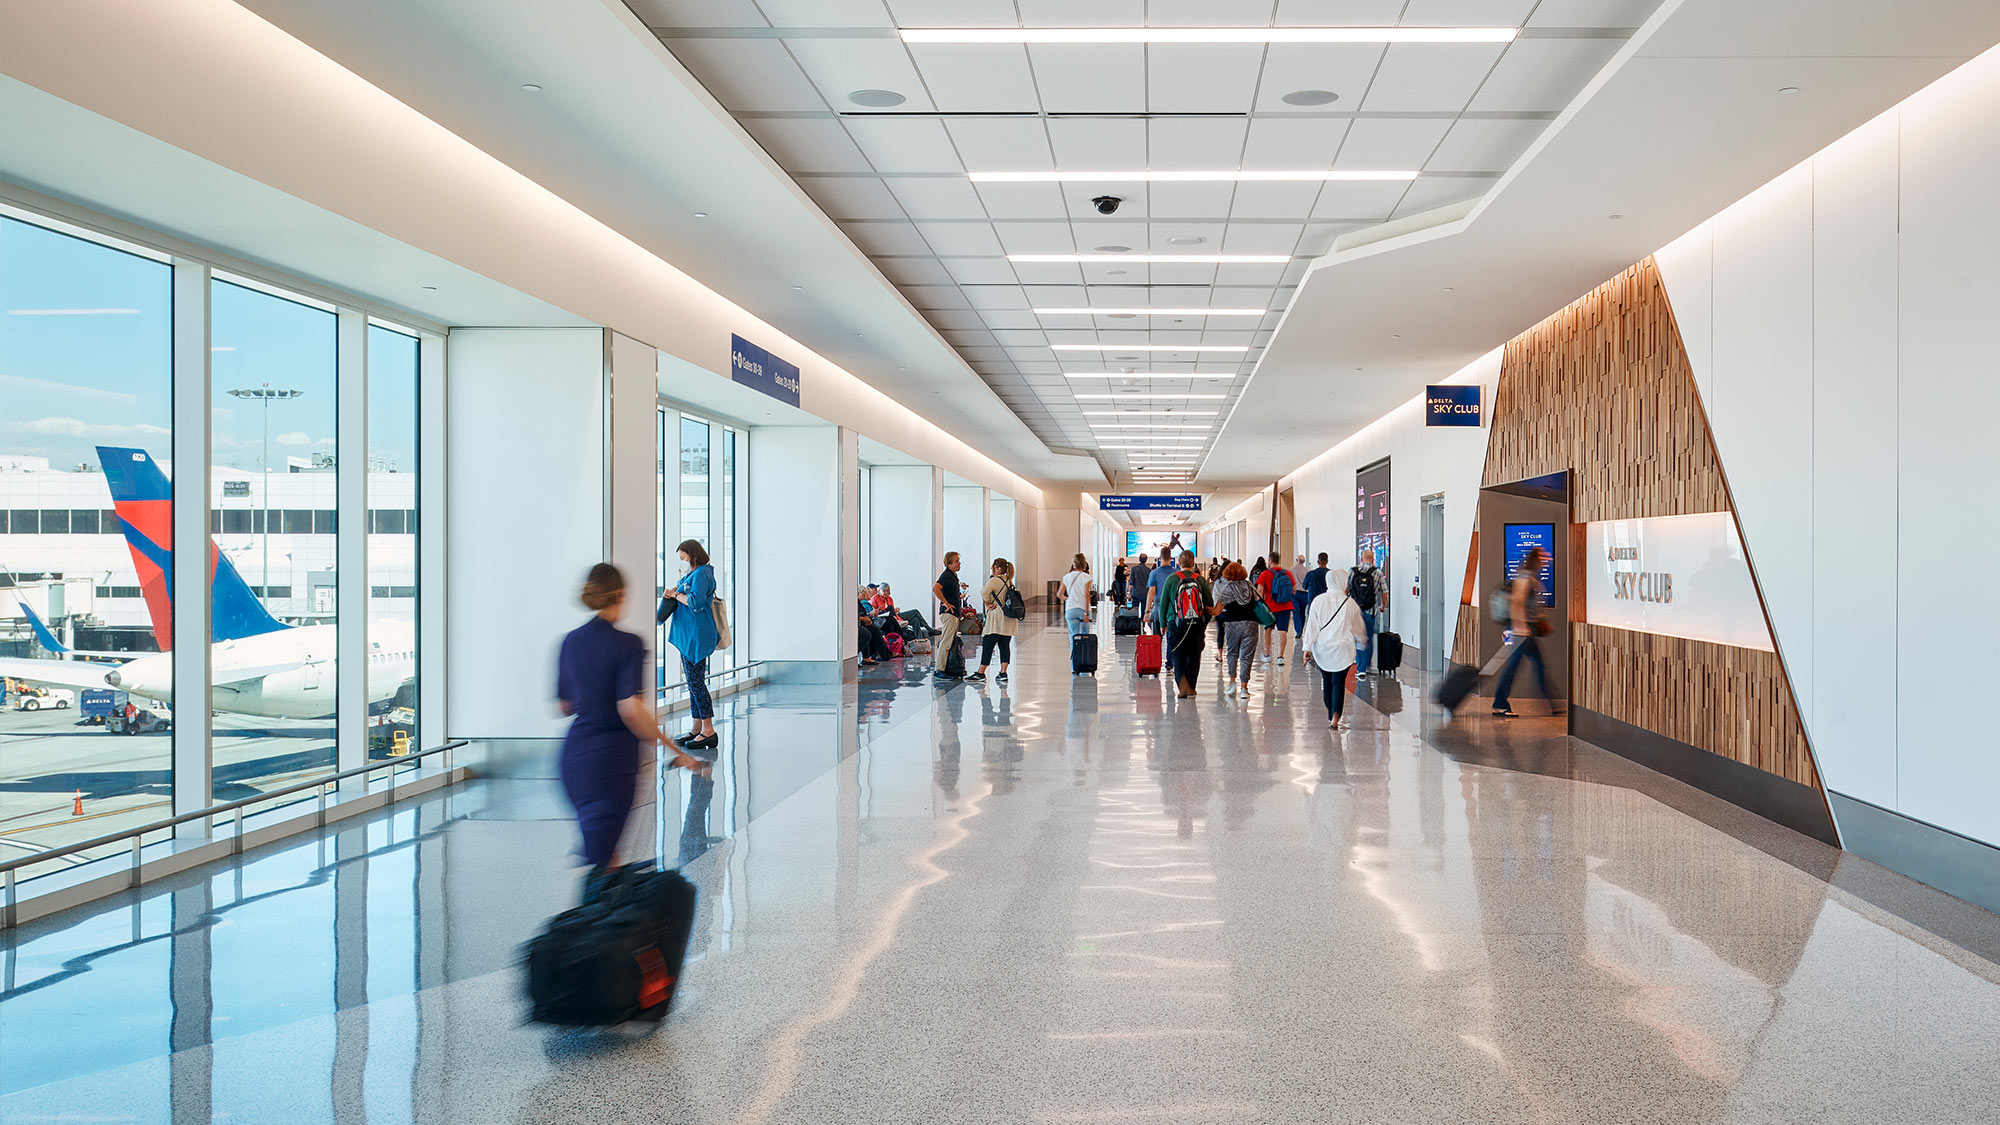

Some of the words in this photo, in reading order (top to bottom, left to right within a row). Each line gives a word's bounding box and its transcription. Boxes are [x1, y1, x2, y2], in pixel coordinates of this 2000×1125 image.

[743, 357, 752, 372] Gates
[775, 372, 783, 385] Gates
[1433, 404, 1453, 414] SKY
[1454, 404, 1480, 414] CLUB
[1614, 547, 1638, 561] DELTA
[1614, 571, 1637, 600] SKY
[1638, 572, 1673, 604] CLUB
